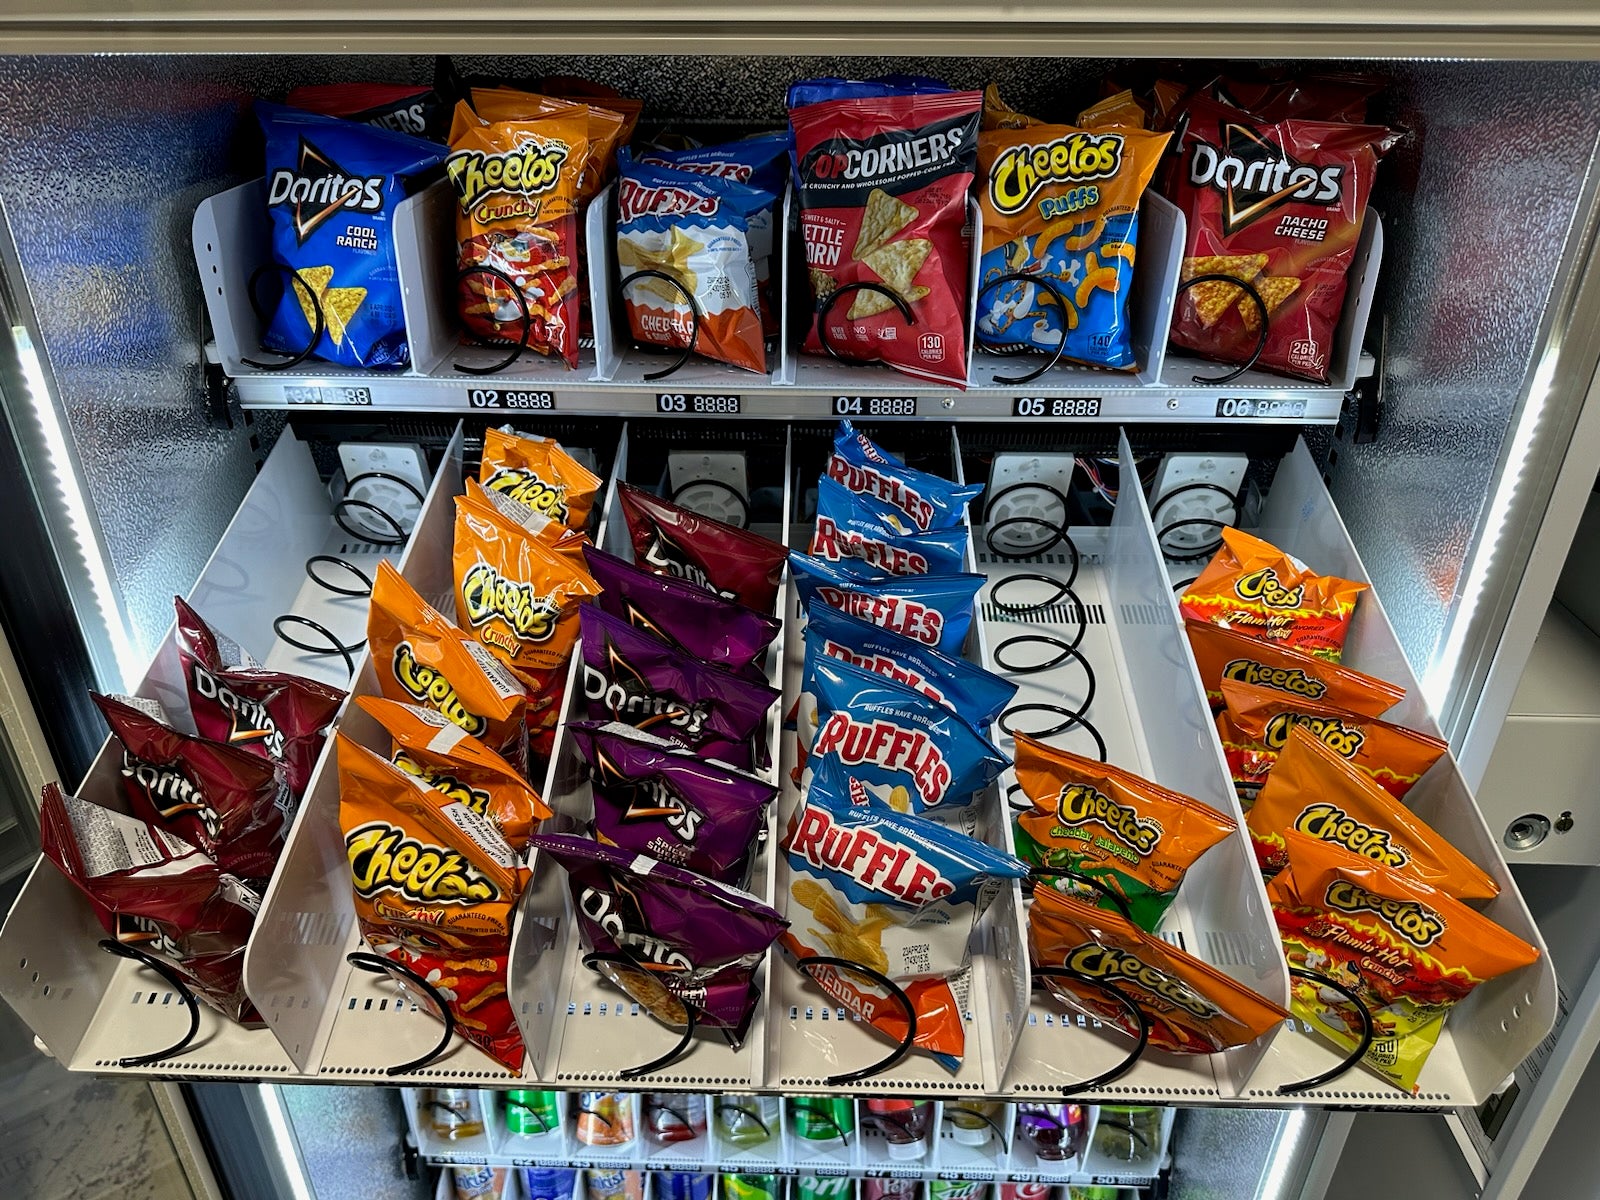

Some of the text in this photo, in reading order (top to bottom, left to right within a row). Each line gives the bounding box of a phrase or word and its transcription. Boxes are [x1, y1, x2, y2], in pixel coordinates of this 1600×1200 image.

[812, 127, 964, 180] OPCORNERS
[446, 146, 564, 213] Cheetos
[642, 159, 753, 184] FFLES
[856, 175, 897, 189] WHOLESOME
[896, 164, 942, 182] POPPED-CORN
[991, 135, 1122, 211] Cheetos
[1190, 145, 1342, 201] Doritos
[269, 172, 382, 210] Doritos
[618, 178, 720, 223] RUFS
[1038, 186, 1099, 220] Puffs
[475, 199, 541, 223] Crunchy
[804, 214, 820, 222] SWEET
[824, 217, 840, 226] SALTY
[1281, 215, 1328, 230] NACHO
[336, 235, 378, 250] RANCH
[347, 225, 377, 238] COOL
[802, 223, 845, 246] ETTLE
[1274, 225, 1326, 241] CHEESE
[804, 241, 842, 267] ORN
[641, 314, 694, 336] CHEDAR
[921, 336, 941, 349] 130
[472, 390, 552, 409] 02 8888
[660, 394, 739, 413] 03 8888
[836, 396, 915, 415] 04 8888
[1018, 398, 1099, 416] 05 8888
[1222, 399, 1250, 417] 06
[857, 433, 889, 466] UFFLES
[484, 468, 568, 526] Cheet
[829, 455, 933, 531] RUFFLES
[463, 566, 558, 638] Cheetos
[817, 586, 943, 645] RUFFLES
[1228, 609, 1295, 627] Flam Hot
[480, 623, 521, 658] Crunchy
[863, 643, 890, 654] RUFFLES
[891, 650, 907, 659] HAVE
[825, 641, 956, 711] RUFFL
[1223, 659, 1328, 700] Cheetos
[194, 665, 285, 759] Doritos
[584, 665, 709, 735] Doritos
[864, 704, 895, 716] RUFFLES
[894, 709, 911, 719] HAVE
[669, 734, 695, 752] SPI
[1265, 713, 1364, 759] Cheetos
[816, 714, 951, 804] RUFFLES
[849, 775, 871, 808] FLES
[637, 780, 703, 841] ritos
[848, 809, 880, 822] RUFFLES
[1060, 784, 1158, 853] Cheetos
[646, 840, 686, 862] SWEET
[655, 836, 686, 858] SPICY
[1050, 826, 1141, 864] Cheddar Jalapeño
[1296, 805, 1407, 868] Cheetos
[348, 826, 494, 901] Cheetos
[792, 808, 956, 908] RUFFLES
[448, 912, 505, 931] GUARANTEED FRESH
[1327, 882, 1442, 946] Cheetos
[580, 886, 693, 978] Dorito
[1322, 923, 1413, 968] Flamin' Hot
[1069, 943, 1217, 1018] Cheetos
[1360, 956, 1405, 985] Crunchy
[670, 986, 707, 1001] EET
[1124, 988, 1175, 1012] unchy
[456, 1166, 495, 1190] nkist
[591, 1169, 627, 1190] nkist
